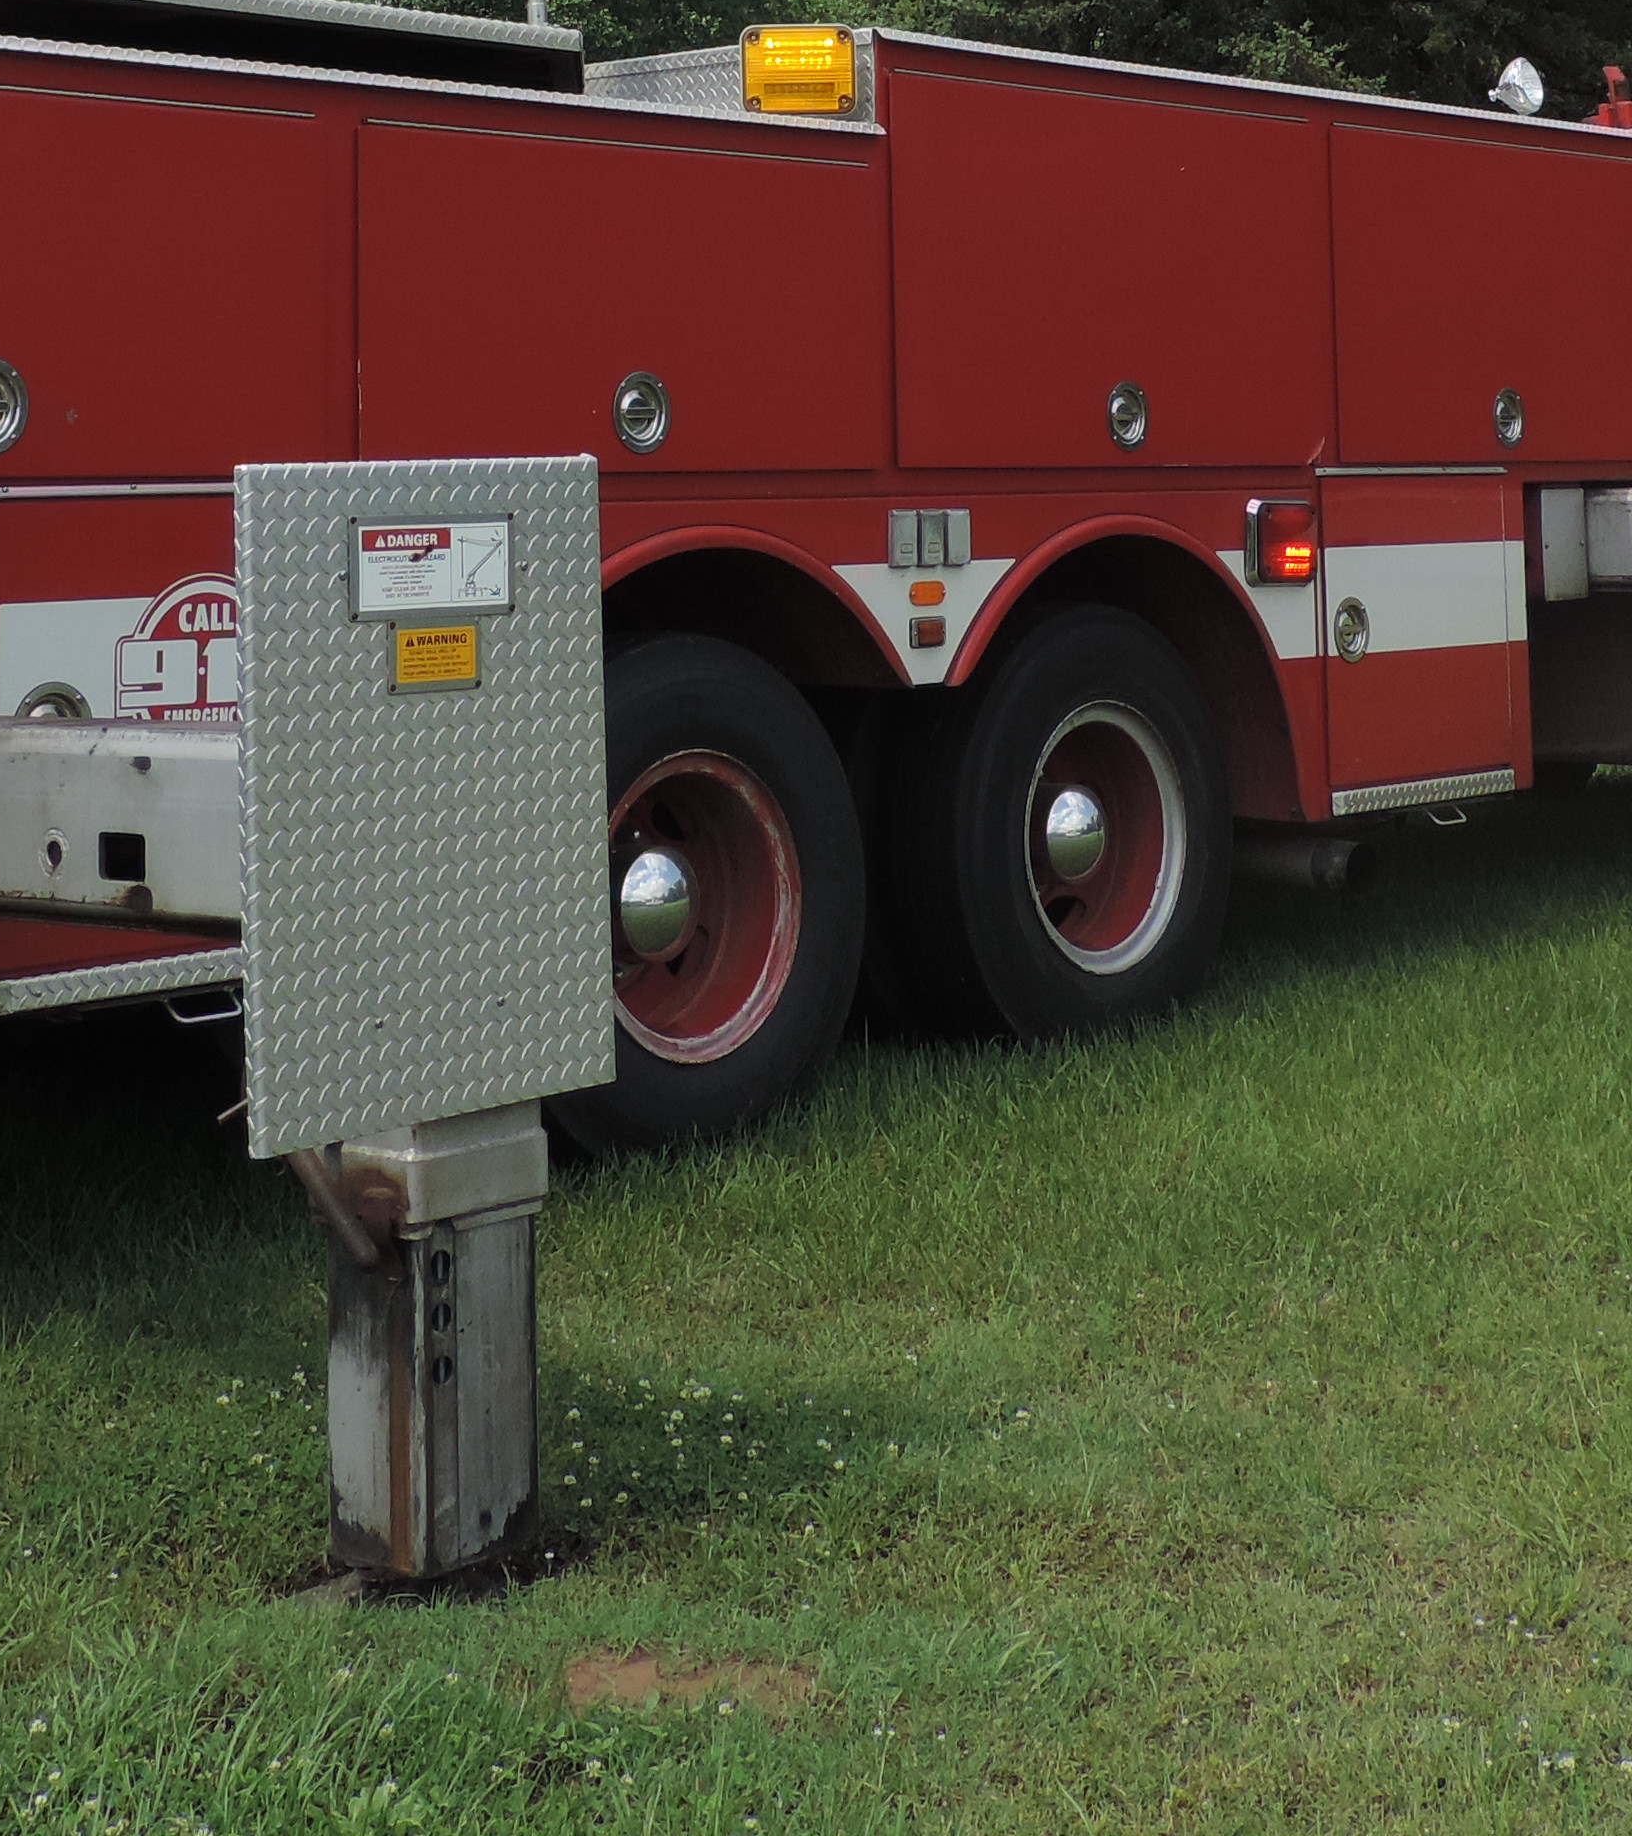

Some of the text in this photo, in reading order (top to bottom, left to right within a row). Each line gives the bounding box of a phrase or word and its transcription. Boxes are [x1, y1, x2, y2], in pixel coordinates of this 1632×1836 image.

[387, 533, 438, 547] DANGER
[178, 602, 235, 633] CALL
[417, 633, 467, 646] WARNING
